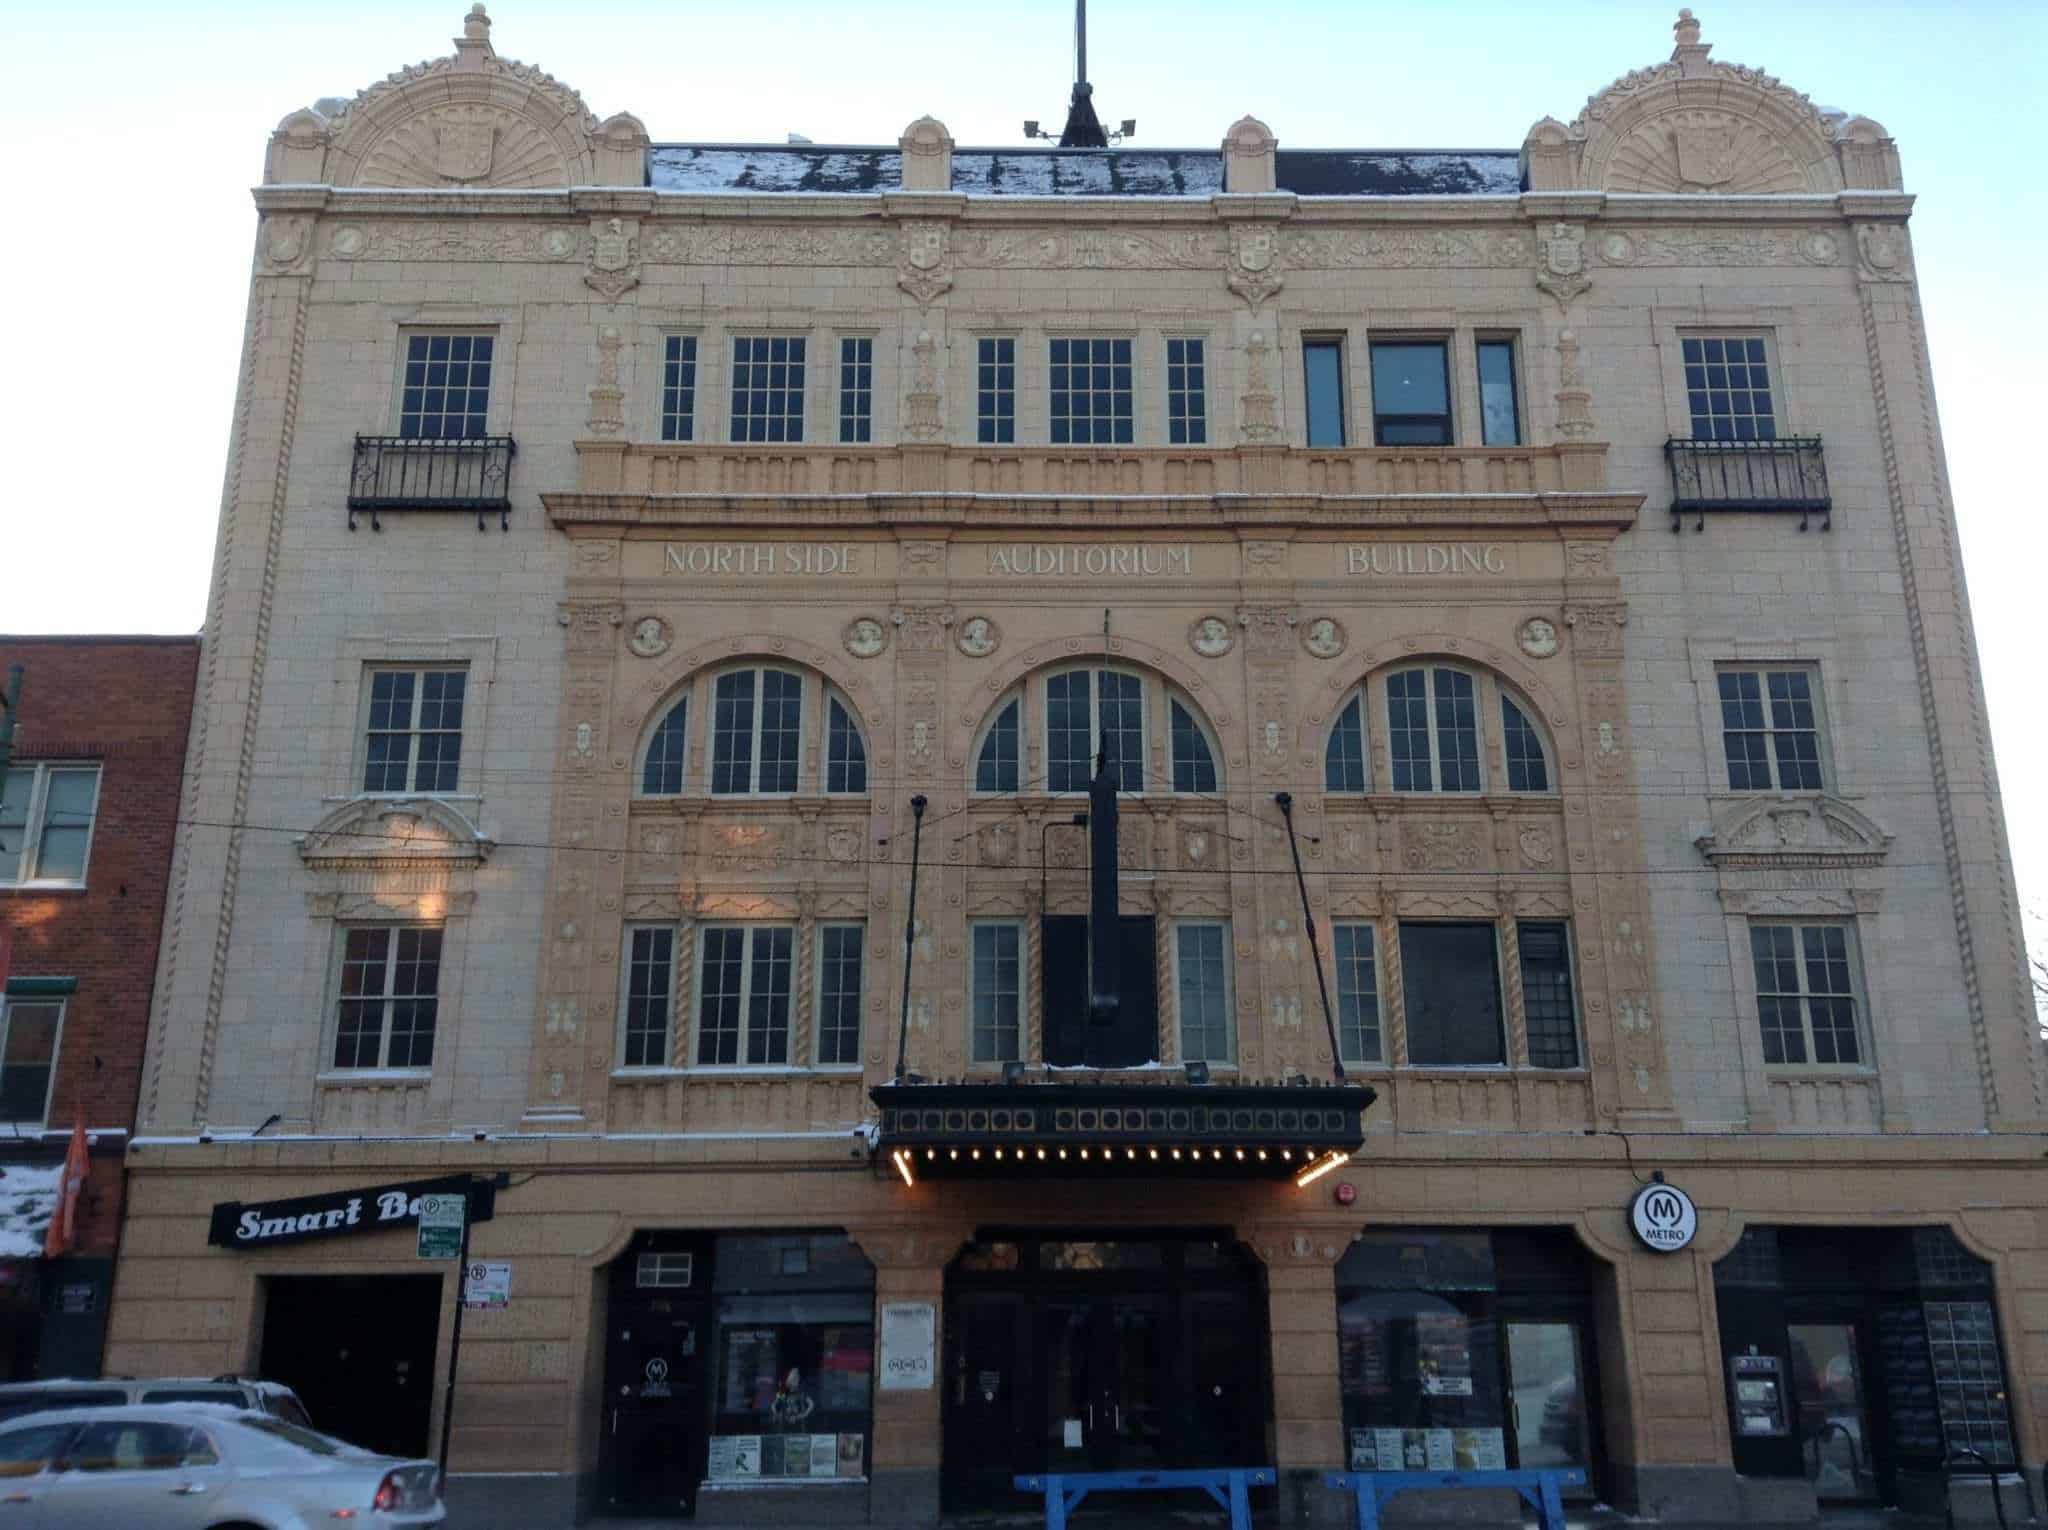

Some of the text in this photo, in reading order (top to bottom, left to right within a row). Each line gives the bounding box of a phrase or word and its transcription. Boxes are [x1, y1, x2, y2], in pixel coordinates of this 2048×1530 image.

[664, 544, 858, 576] NORTH SIDE
[987, 544, 1193, 576] AUDITORIUM
[1348, 543, 1505, 575] BUILDING
[235, 1198, 363, 1240] Smart
[376, 1191, 422, 1221] Ba
[1646, 1229, 1685, 1241] METRO
